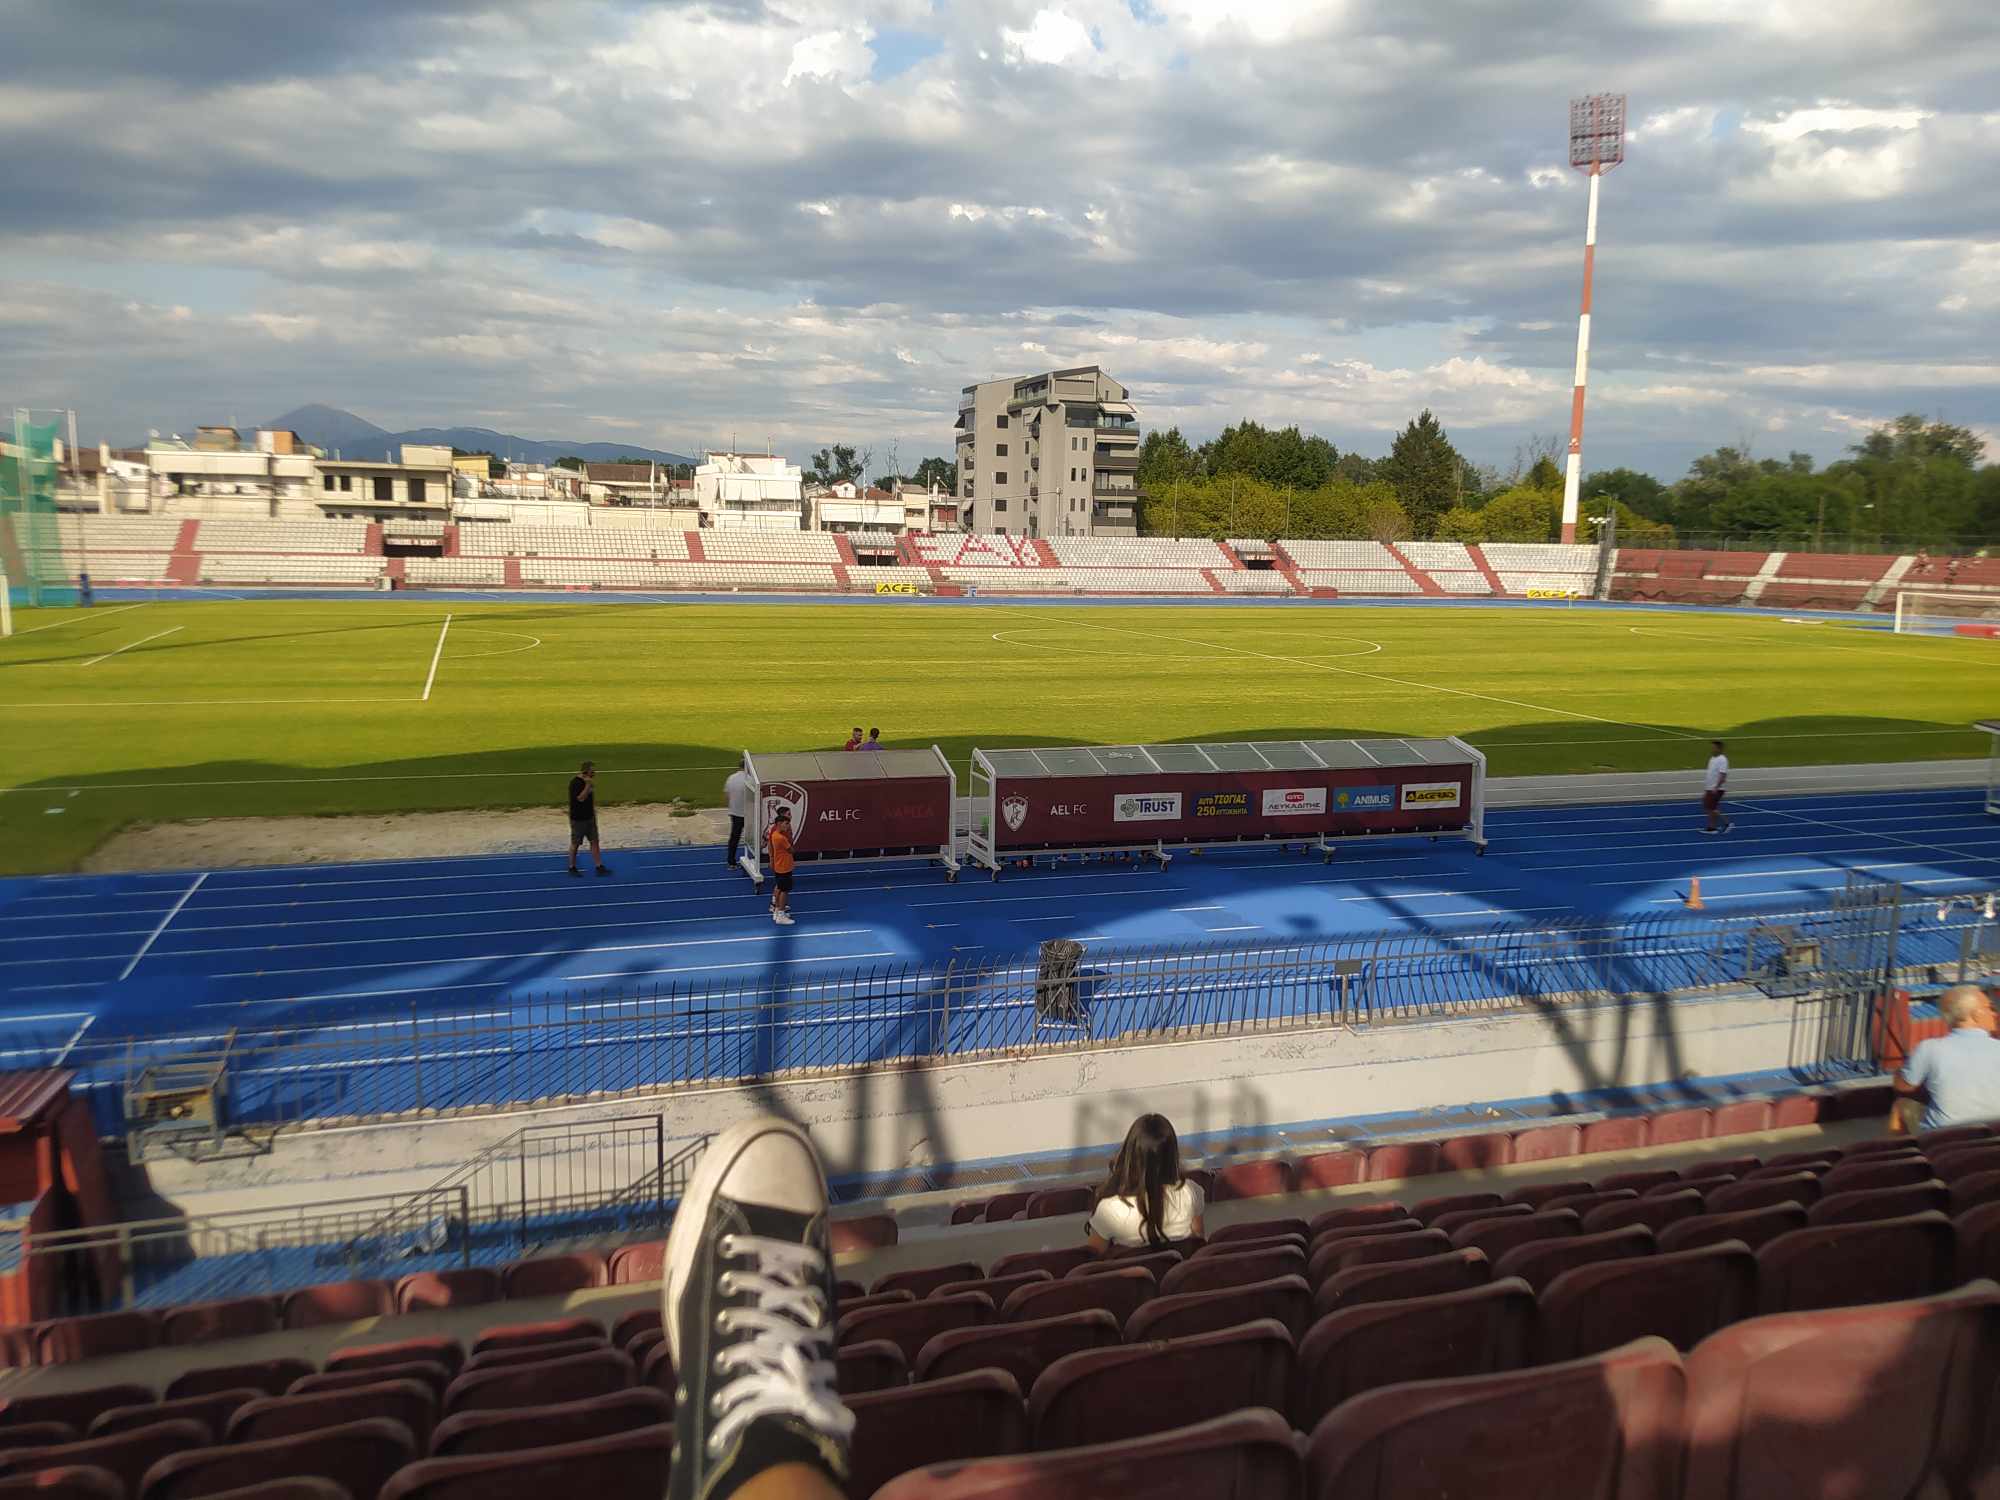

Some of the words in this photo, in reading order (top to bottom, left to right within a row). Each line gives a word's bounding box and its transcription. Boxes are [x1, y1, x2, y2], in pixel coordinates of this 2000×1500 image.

[1135, 798, 1175, 813] TRUST
[1353, 793, 1392, 805] ANIMUS
[819, 809, 842, 822] AEL
[845, 808, 863, 820] FC
[1050, 804, 1072, 816] AEL
[1073, 803, 1088, 815] FC
[1196, 805, 1216, 816] 250
